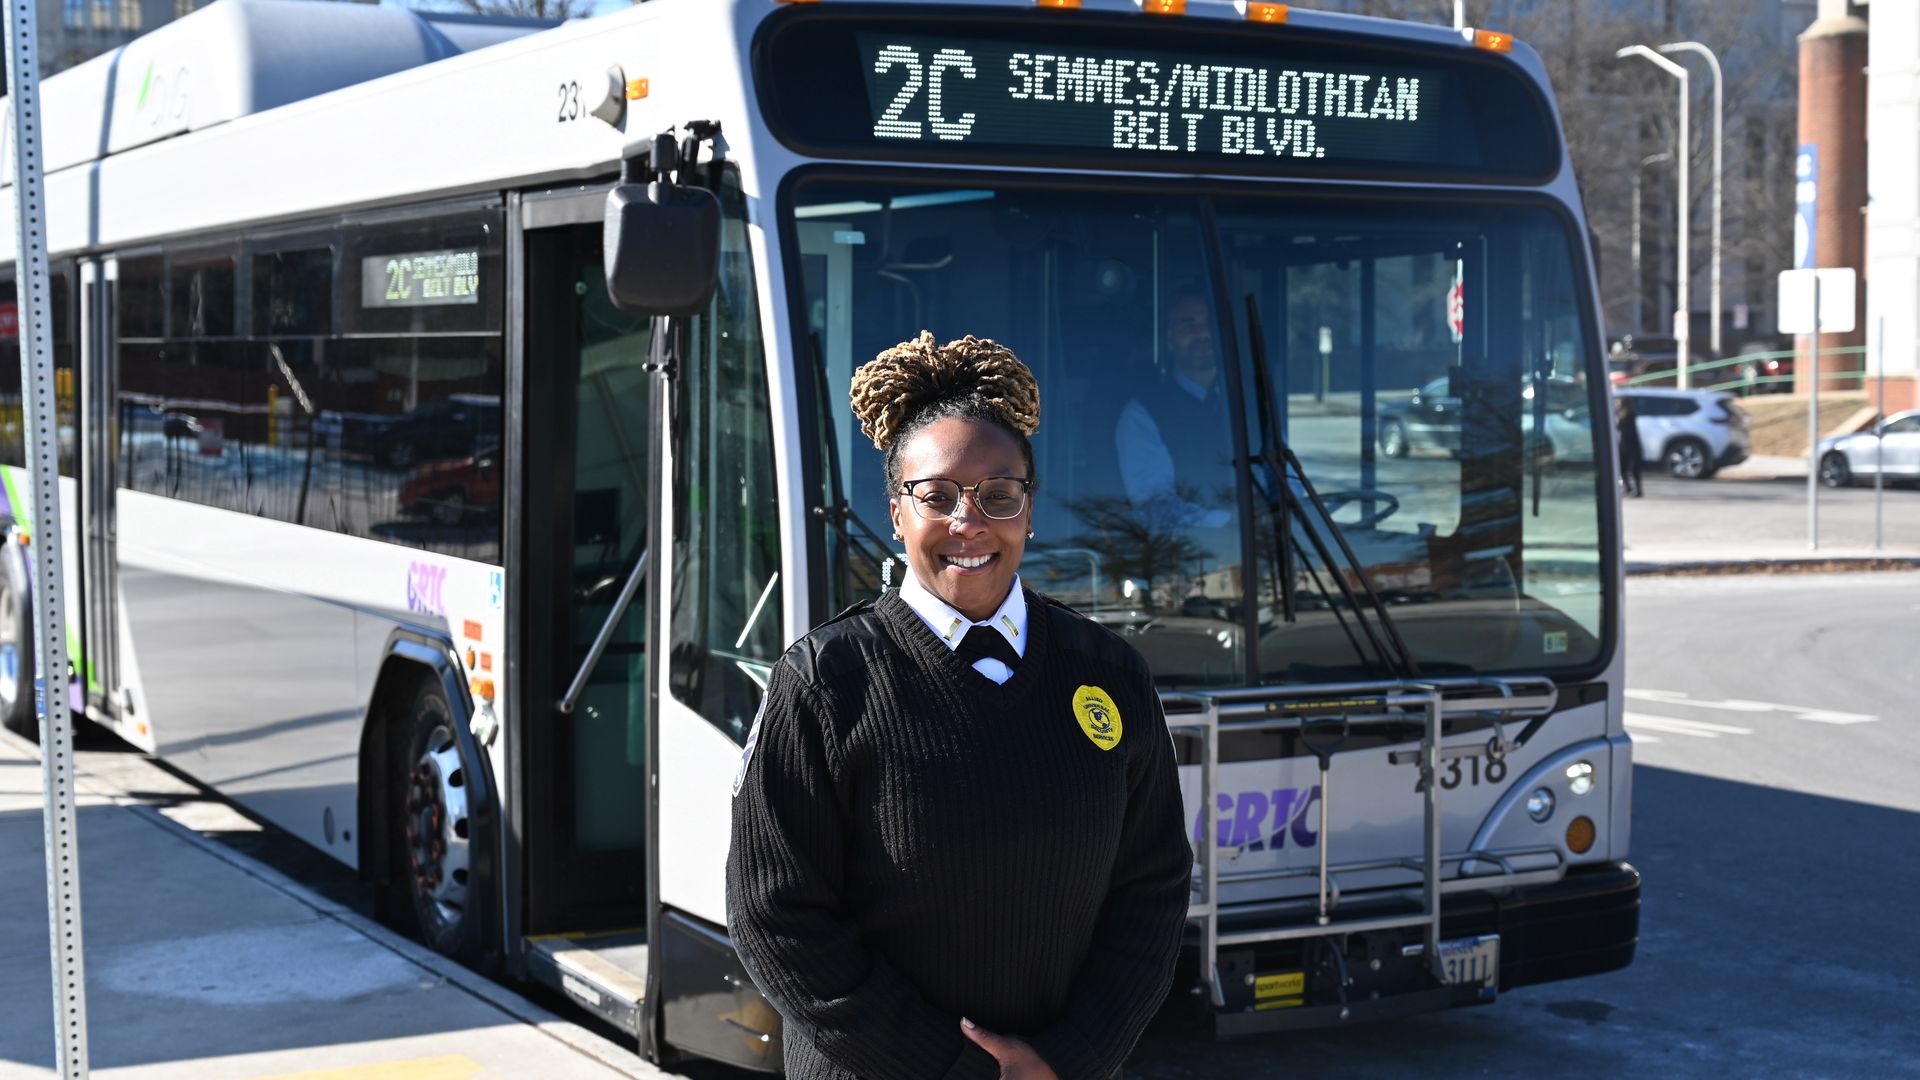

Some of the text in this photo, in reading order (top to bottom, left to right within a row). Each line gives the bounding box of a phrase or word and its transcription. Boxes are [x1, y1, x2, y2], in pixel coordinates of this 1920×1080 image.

[874, 45, 976, 141] 2C
[1008, 52, 1420, 121] SEMMES/MIDLOTHIAN
[1112, 109, 1325, 158] BELT BLVD.
[385, 258, 412, 300] 2C
[1414, 755, 1507, 793] 318
[1193, 785, 1322, 852] GRTC
